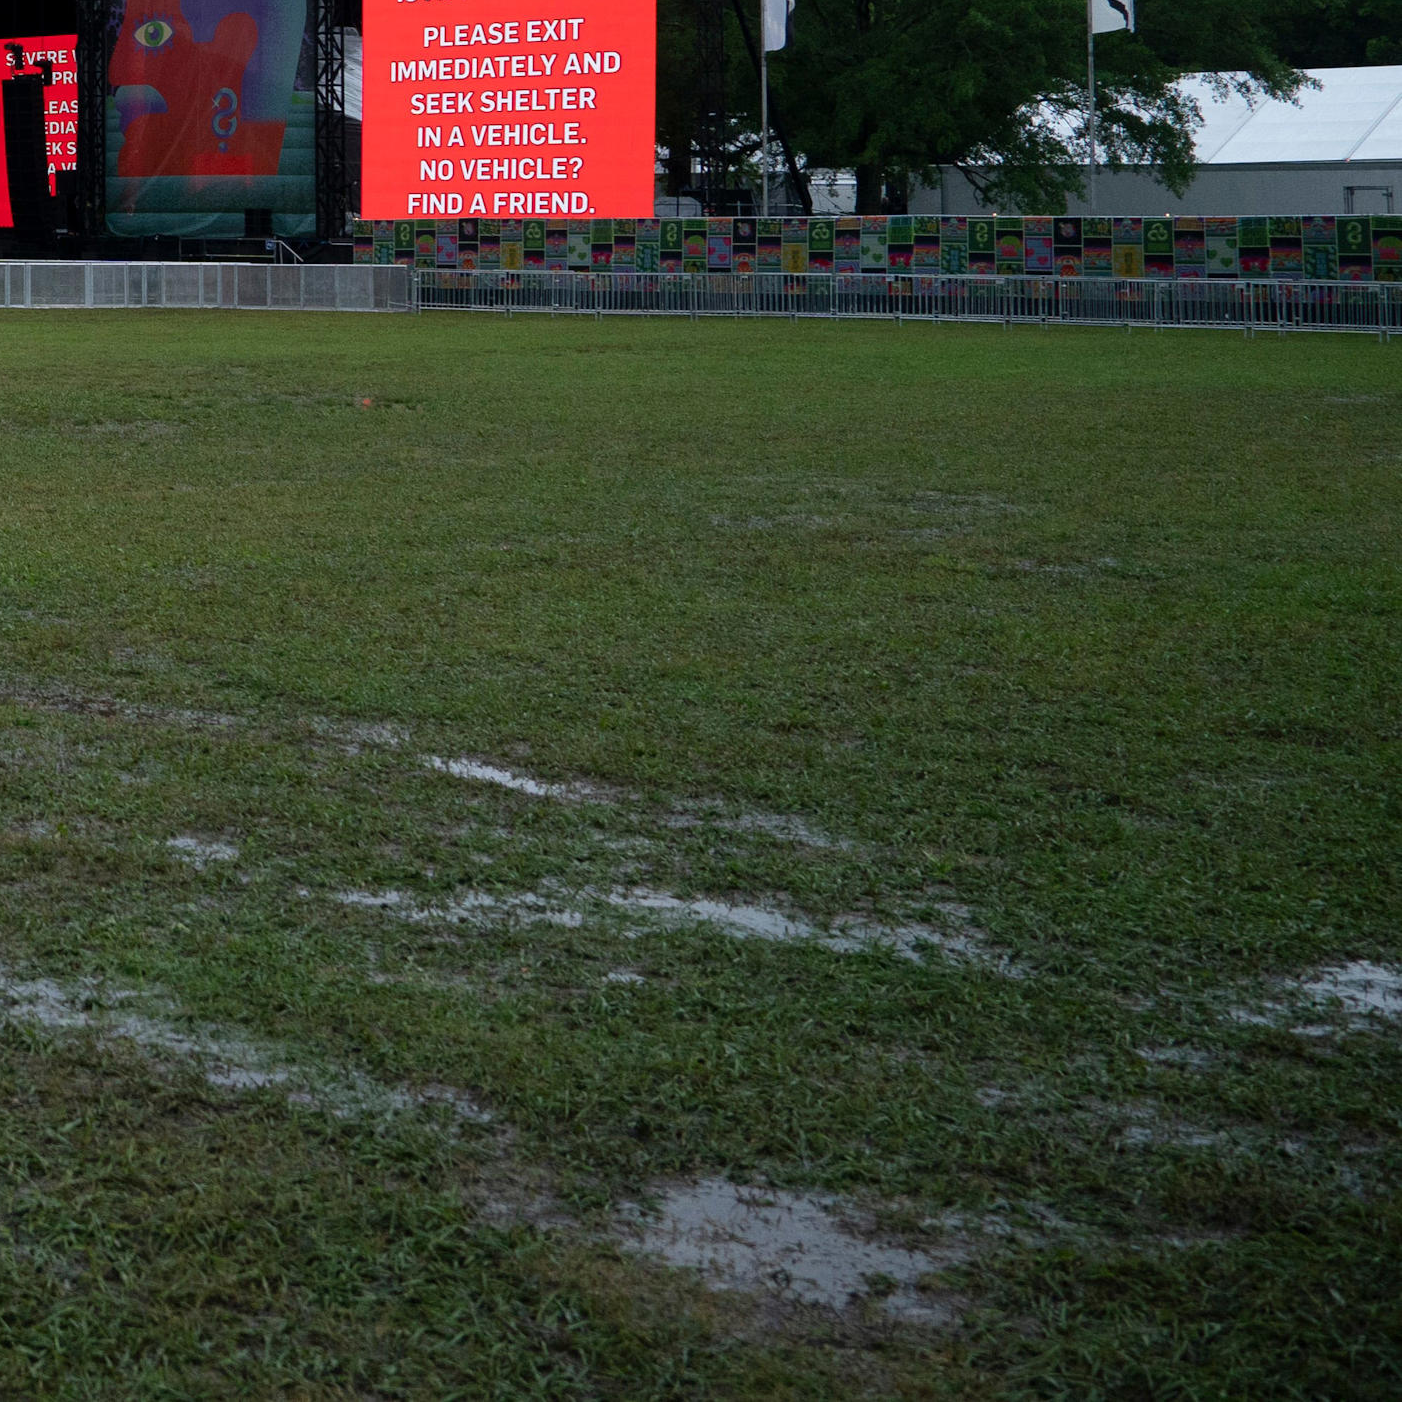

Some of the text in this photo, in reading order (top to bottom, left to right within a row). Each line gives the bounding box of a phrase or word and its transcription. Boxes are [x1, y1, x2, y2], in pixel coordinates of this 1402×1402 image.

[423, 18, 584, 48] PLEASE EXIT
[390, 51, 621, 82] IMMEDIATELY AND
[410, 87, 596, 115] SEEK SHELTER
[417, 122, 587, 148] IN A VEHICLE.
[420, 157, 583, 181] NO VEHICLE?
[407, 192, 595, 214] FIND A FRIEND.
